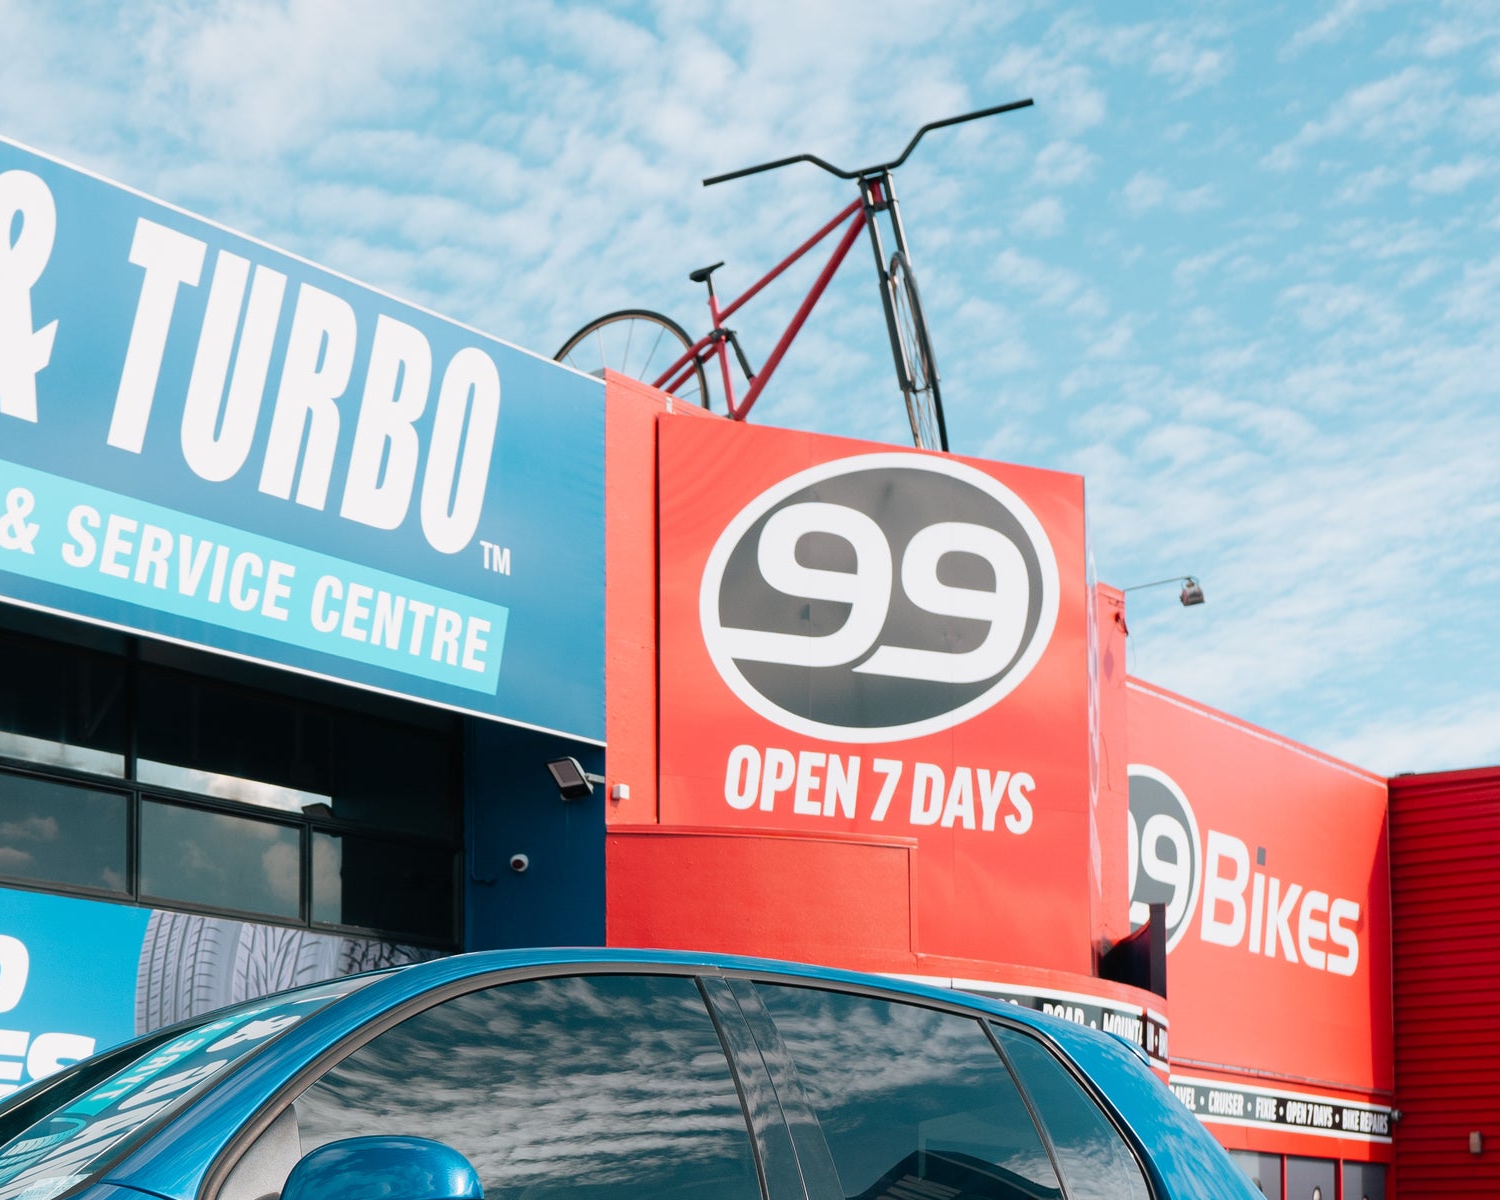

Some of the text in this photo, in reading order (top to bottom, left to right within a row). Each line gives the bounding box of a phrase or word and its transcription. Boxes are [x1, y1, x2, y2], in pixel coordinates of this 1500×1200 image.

[106, 216, 501, 554] TURBO
[61, 505, 296, 621] SERVICE
[310, 575, 491, 674] CENTRE
[479, 540, 511, 576] TM
[720, 502, 1030, 684] 99
[724, 744, 1036, 835] OPEN 7 DAYS
[1208, 1090, 1244, 1116] CRUISER
[1255, 1097, 1278, 1121] FIXIE
[1286, 1101, 1307, 1125] OPEN
[1307, 1104, 1313, 1126] 7
[1313, 1105, 1333, 1128] DAYS
[1342, 1109, 1360, 1131] BIKE
[1360, 1111, 1388, 1135] REPAIRS
